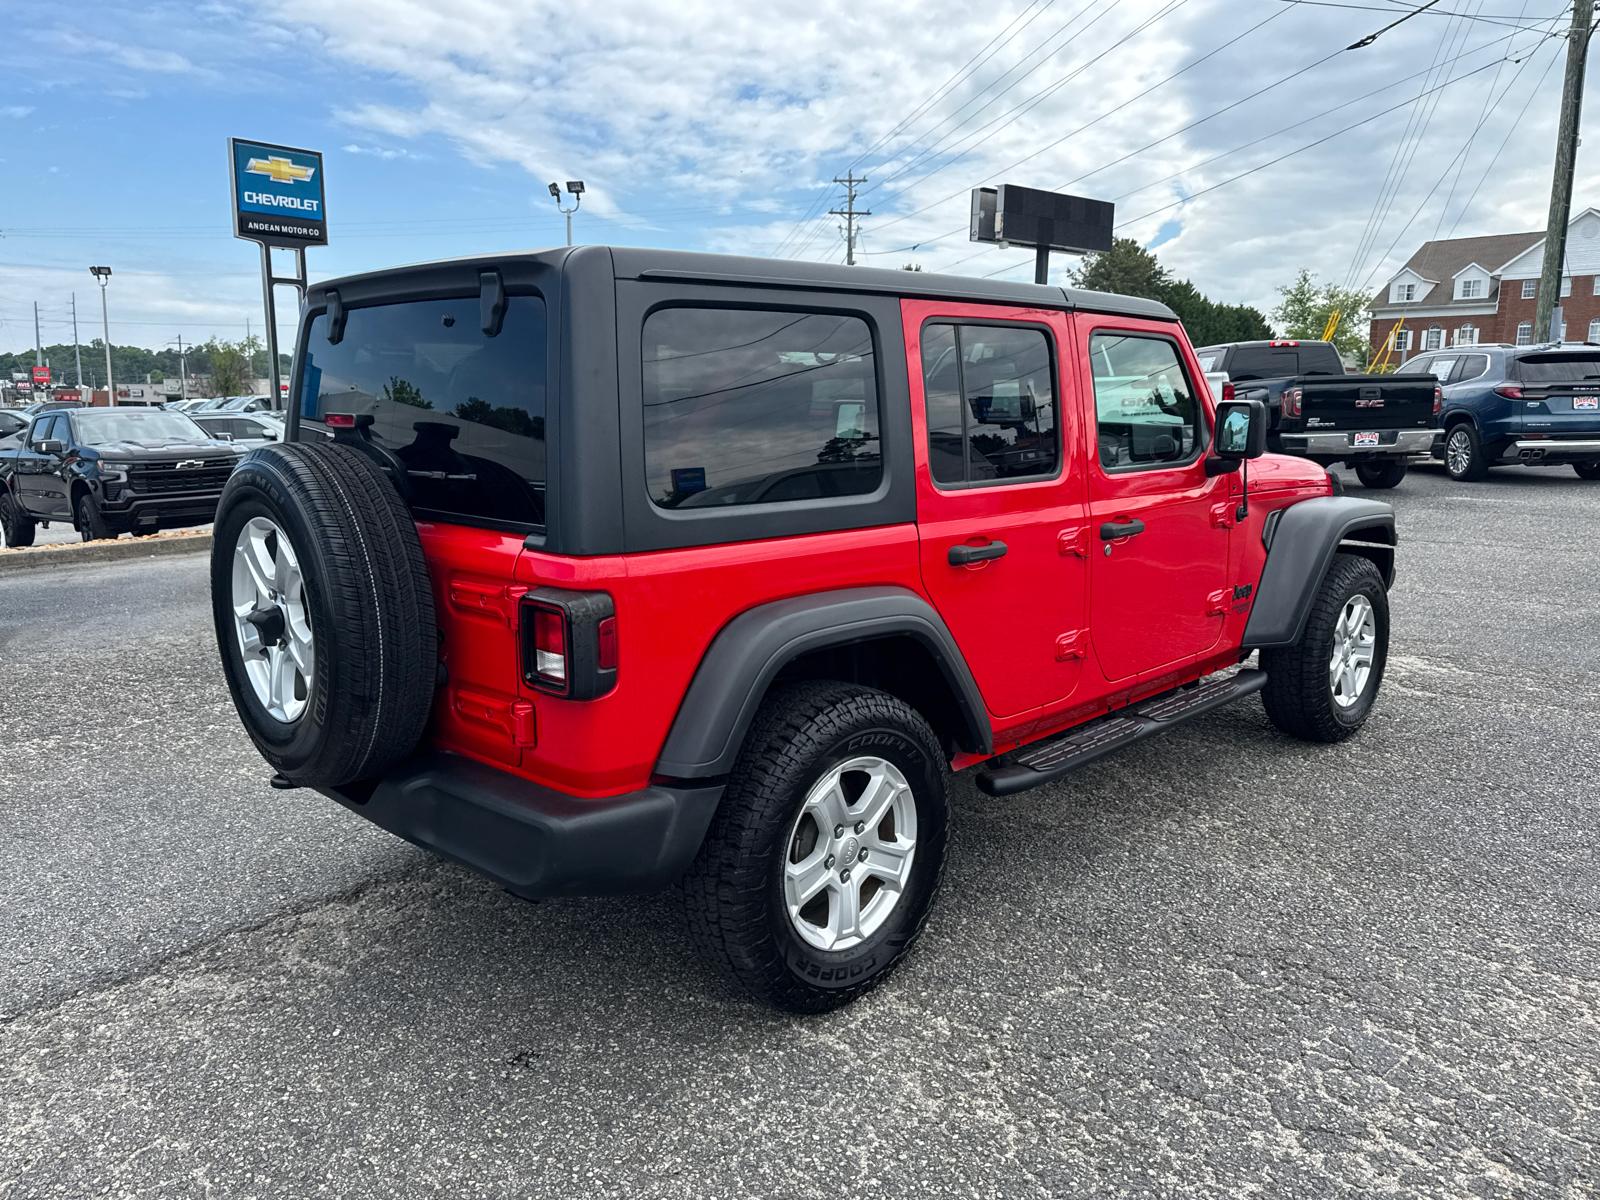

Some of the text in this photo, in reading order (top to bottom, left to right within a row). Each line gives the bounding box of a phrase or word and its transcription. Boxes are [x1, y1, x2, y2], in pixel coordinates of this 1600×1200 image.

[244, 191, 319, 211] CHEVROLET
[248, 221, 320, 236] ANDEAN MOTOR CO
[1355, 399, 1385, 408] GMC
[1232, 583, 1253, 602] Jeep
[848, 734, 922, 763] COOPER
[795, 953, 877, 981] COOPER
